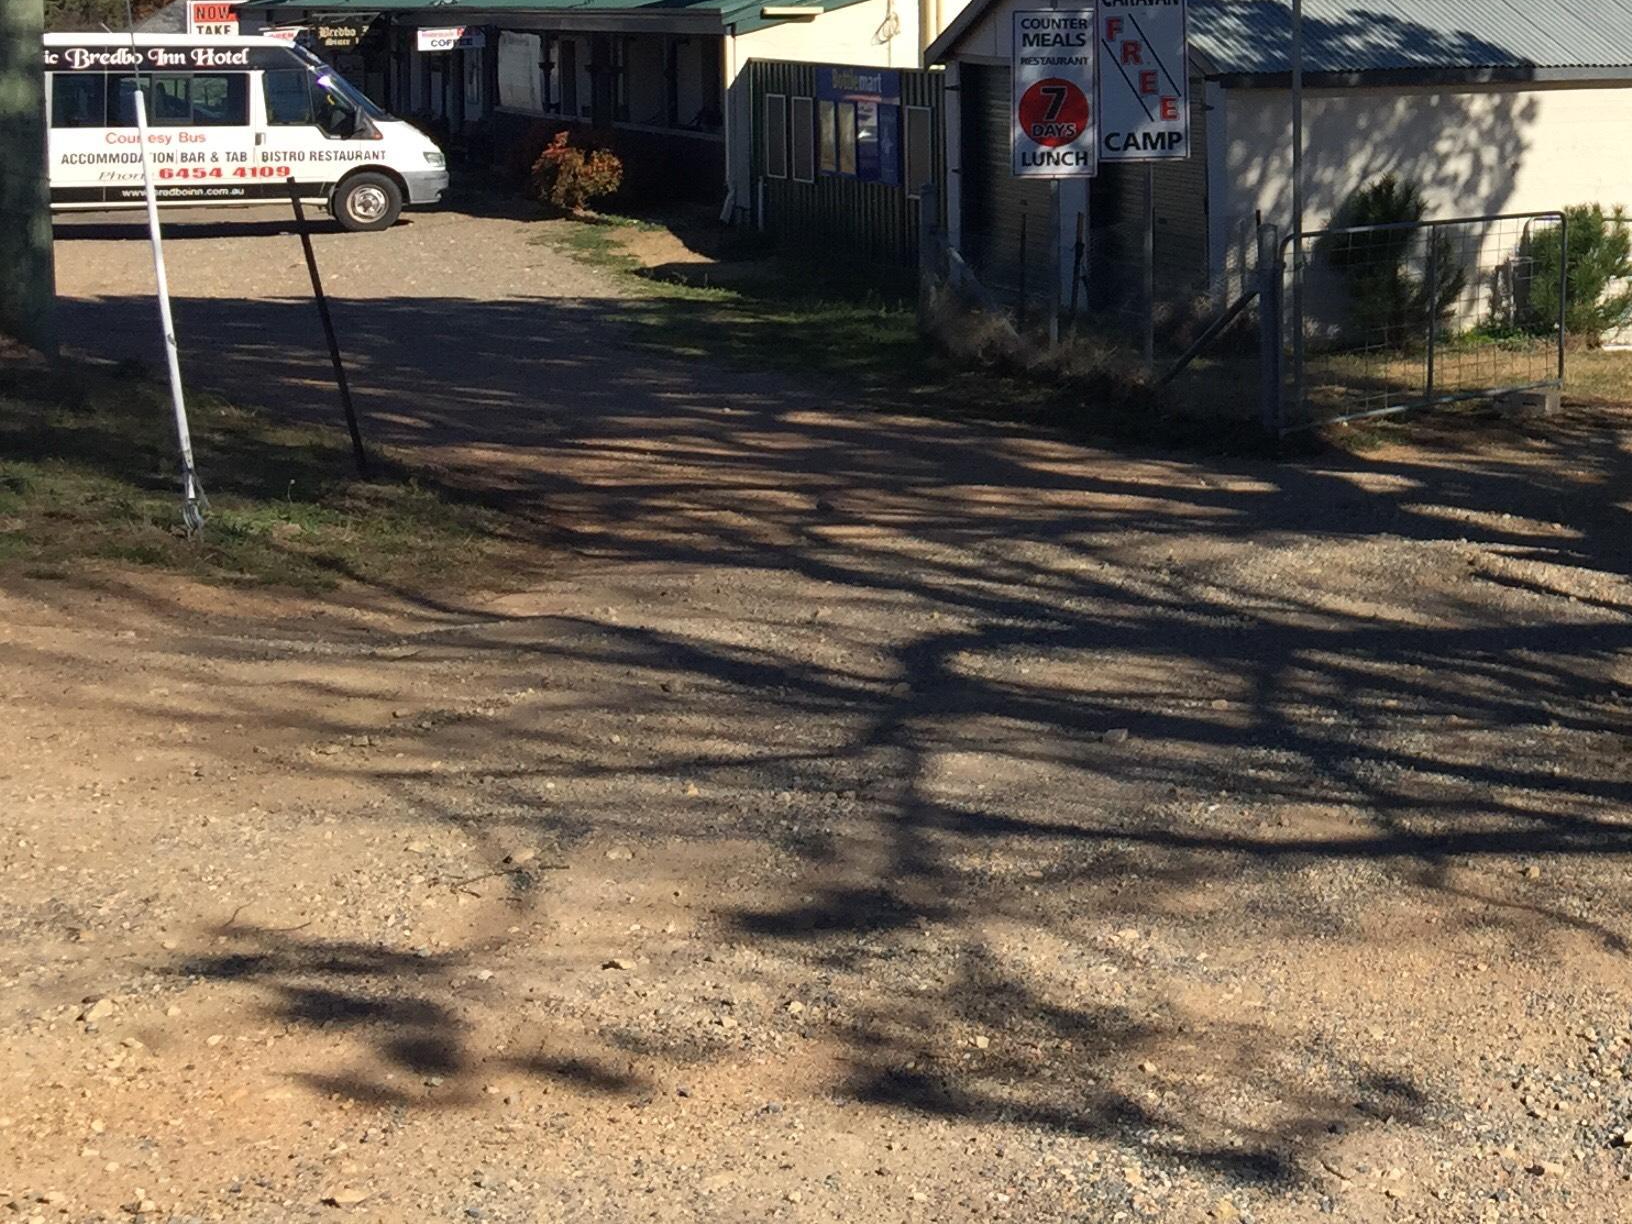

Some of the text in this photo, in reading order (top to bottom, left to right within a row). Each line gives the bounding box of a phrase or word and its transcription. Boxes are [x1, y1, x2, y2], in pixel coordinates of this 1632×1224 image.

[196, 4, 230, 20] NOW
[1020, 17, 1088, 30] COUNTER
[1022, 32, 1087, 48] MEALS
[65, 47, 143, 69] Bredbo
[148, 47, 186, 67] Inn
[190, 47, 250, 67] Hotel
[1020, 56, 1089, 66] RESTAURANT
[1104, 16, 1181, 122] FREE
[1039, 85, 1068, 122] 7
[1032, 122, 1077, 138] DAYS
[105, 132, 206, 146] Couresy Bus
[1104, 131, 1183, 152] CAMP
[61, 149, 386, 165] ACCOMMODAION BAR & TAB BISTRO RESTAURANT
[1021, 151, 1088, 167] LUNCH
[159, 167, 223, 180] 6454
[232, 165, 290, 178] 4109
